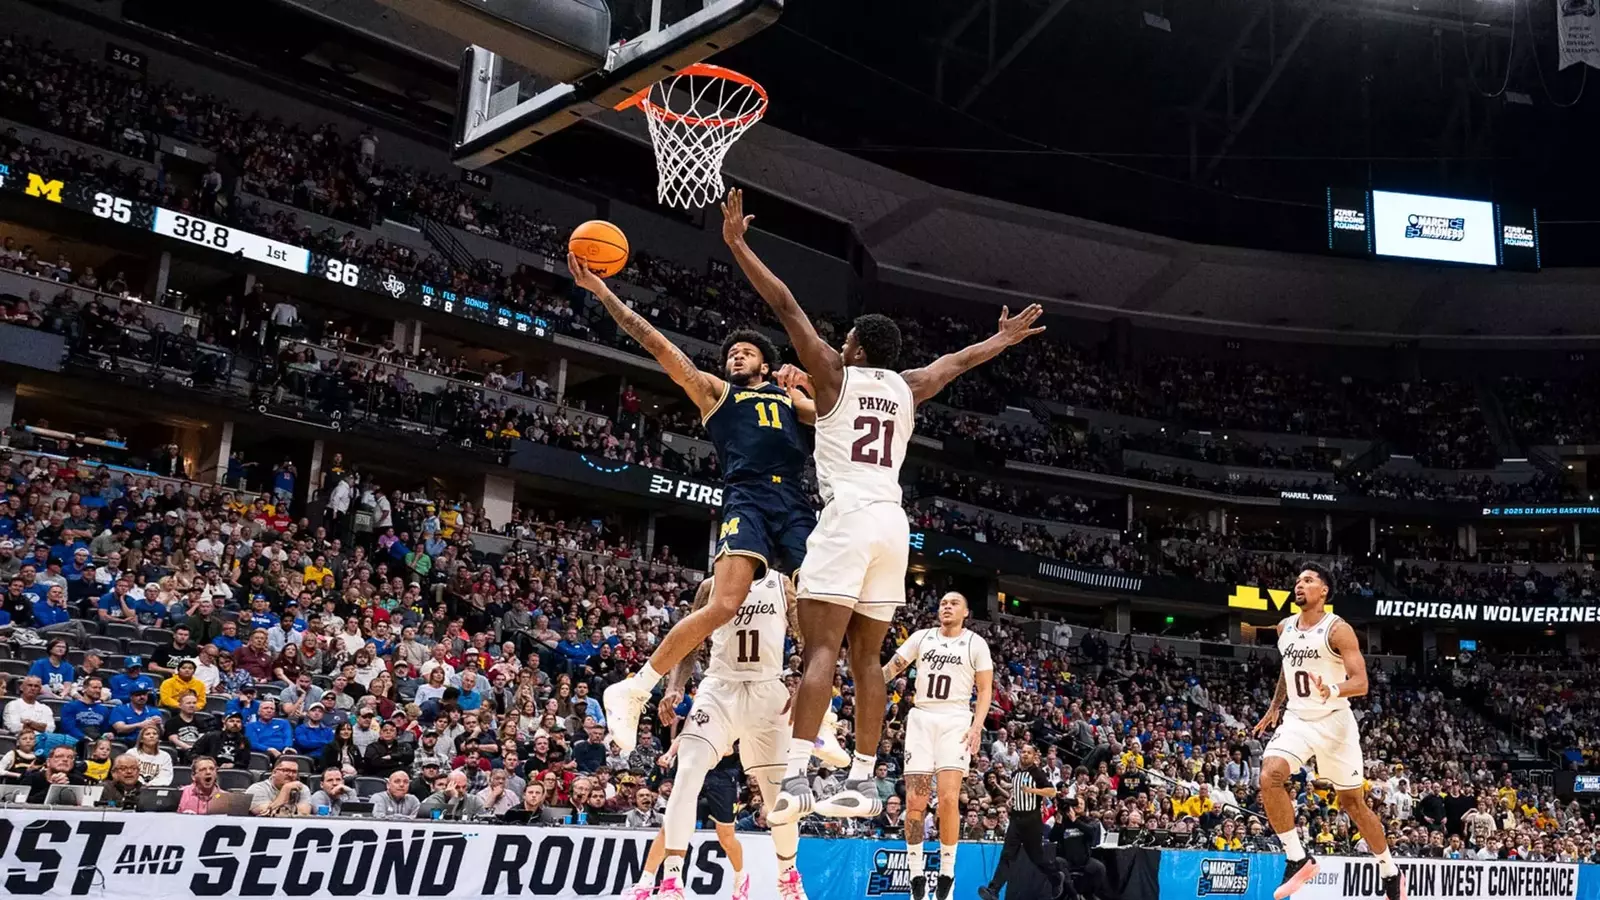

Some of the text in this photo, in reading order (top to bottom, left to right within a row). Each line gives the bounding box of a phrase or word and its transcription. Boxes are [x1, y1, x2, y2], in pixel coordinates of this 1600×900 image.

[113, 49, 140, 67] 342
[25, 172, 65, 203] M
[92, 192, 132, 224] 35
[173, 215, 229, 249] 38.8
[1418, 216, 1449, 228] MARCH
[1421, 225, 1464, 237] MADNESS
[266, 245, 288, 262] 1st
[326, 258, 360, 287] 36
[423, 295, 432, 307] 3
[444, 302, 453, 313] 8
[755, 401, 782, 429] 11
[859, 396, 899, 415] PAYNE
[851, 415, 895, 468] 21
[719, 517, 740, 540] M
[1375, 600, 1600, 622] MICHIGAN WOLVERINE
[736, 629, 761, 663] 11
[1282, 643, 1321, 667] Aggies
[921, 649, 963, 670] Aggies
[926, 673, 952, 700] 10
[1294, 670, 1311, 697] 0
[0, 819, 125, 896] ST
[113, 844, 186, 875] AND
[189, 825, 468, 896] SECOND
[1210, 861, 1236, 875] MARCH
[1212, 875, 1248, 889] MADNESS
[1329, 872, 1339, 885] BY
[1343, 863, 1575, 897] MOUTAIN WEST CONFERENCE
